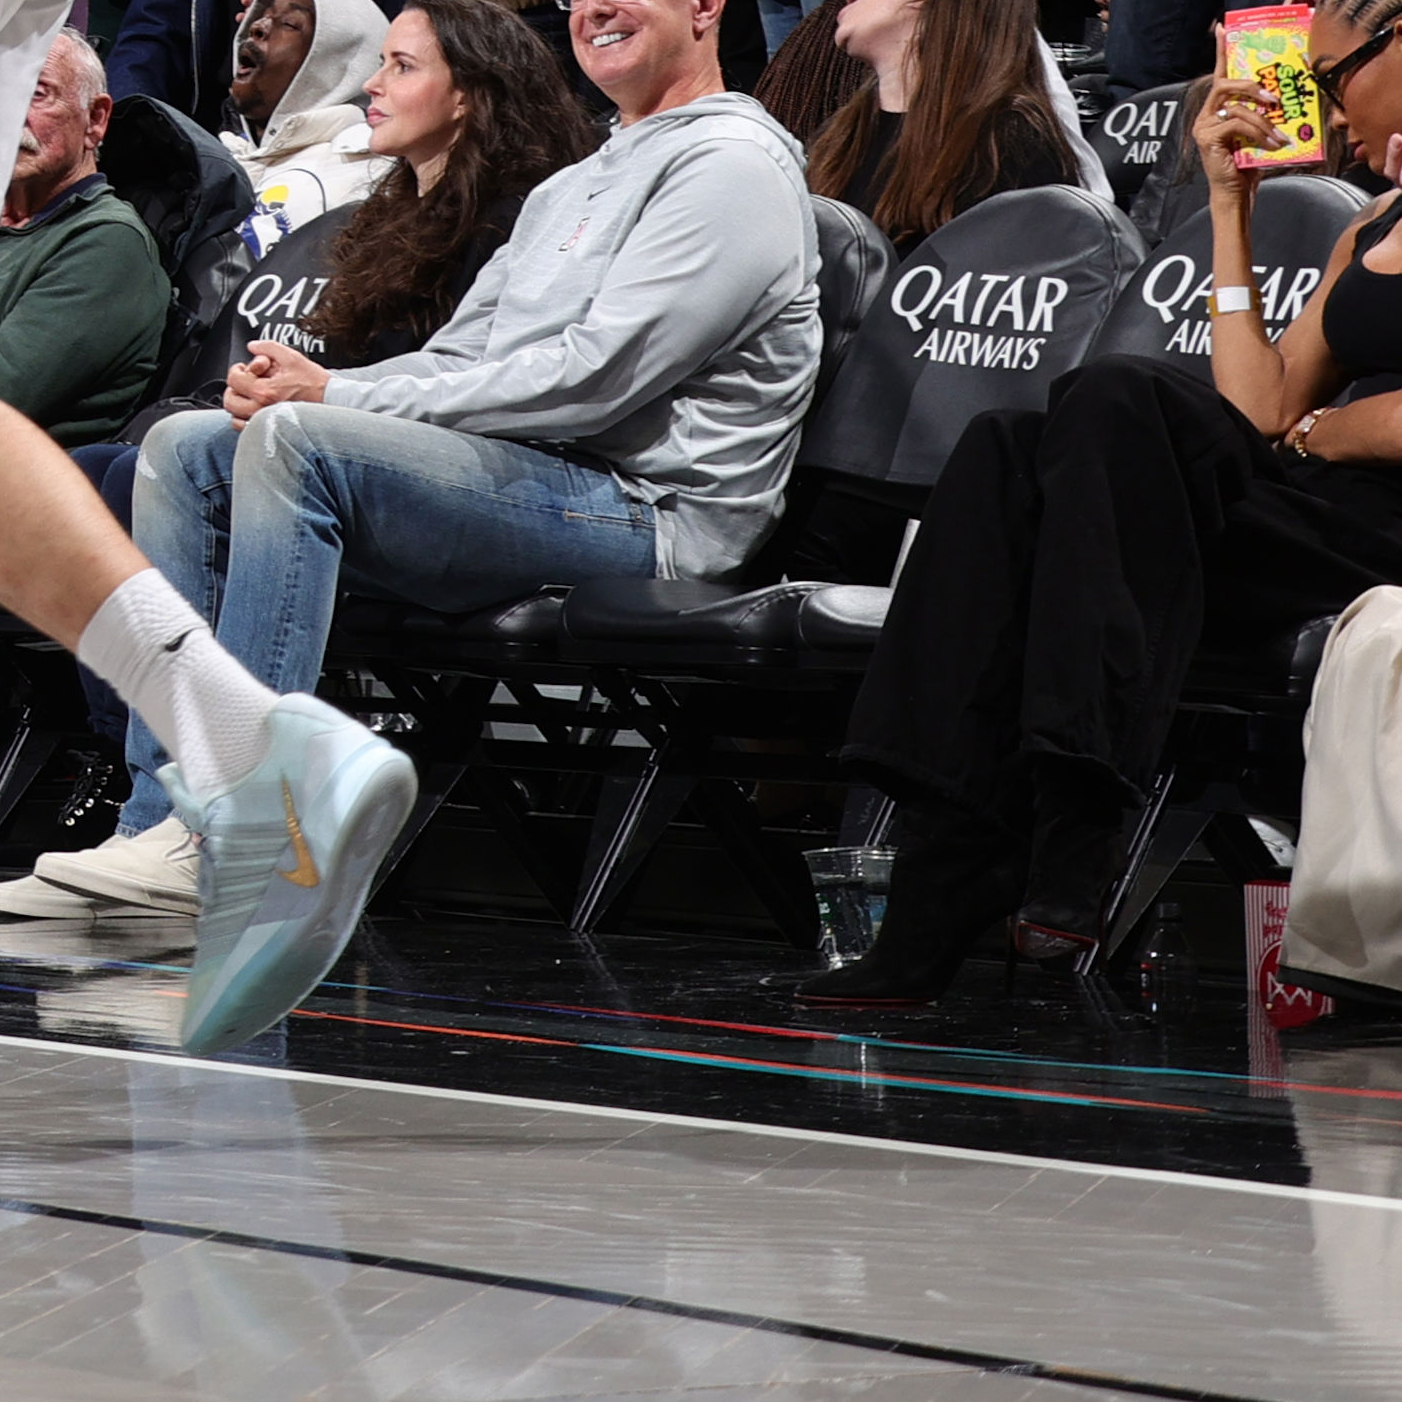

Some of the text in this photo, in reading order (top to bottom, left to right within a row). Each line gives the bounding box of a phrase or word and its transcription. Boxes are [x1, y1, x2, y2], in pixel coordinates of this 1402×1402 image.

[1276, 64, 1303, 121] SOUR
[889, 264, 1070, 334] QATAR
[912, 327, 1048, 372] AIRWAYS
